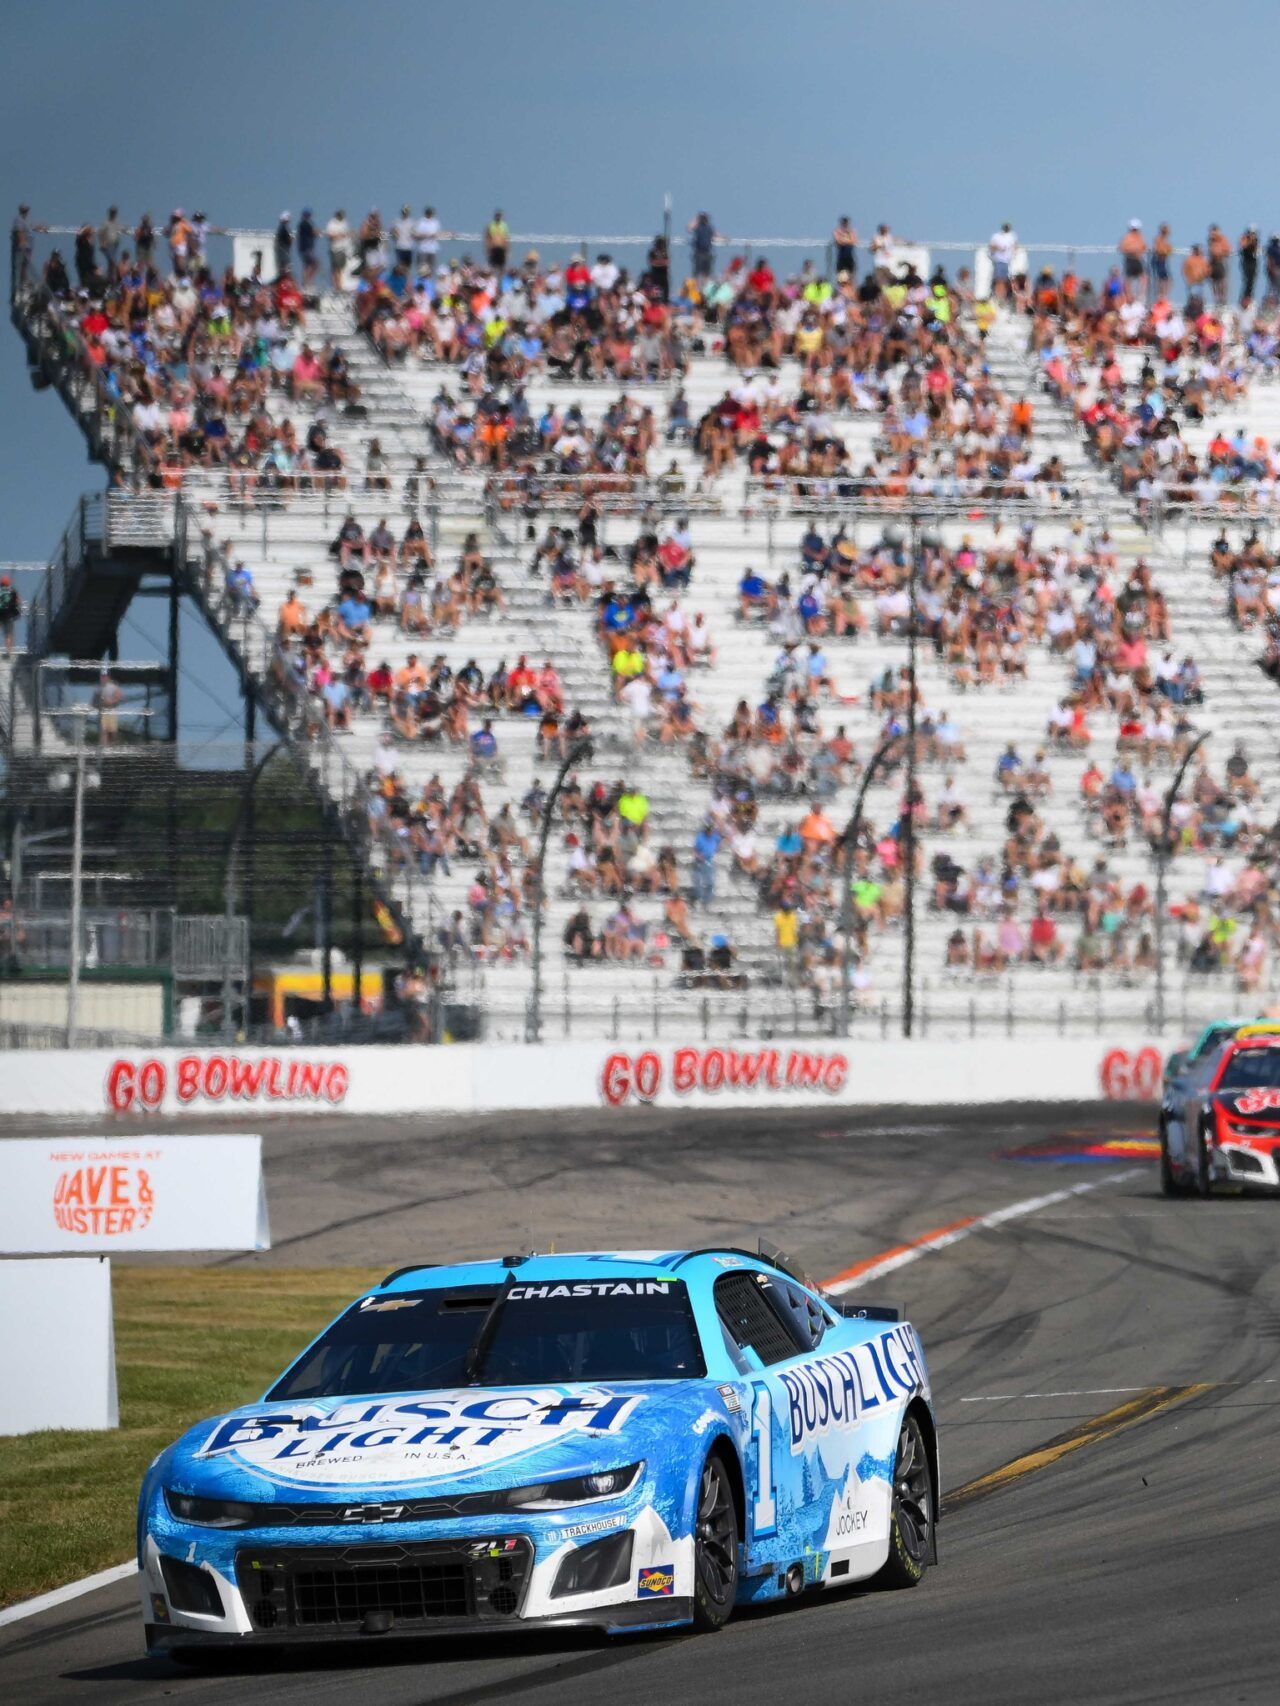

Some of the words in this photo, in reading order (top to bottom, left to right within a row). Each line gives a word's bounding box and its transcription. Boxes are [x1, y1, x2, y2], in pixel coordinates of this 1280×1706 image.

[107, 1059, 166, 1112] GO
[176, 1055, 349, 1103] BOWLING
[602, 1051, 662, 1105] GO
[673, 1047, 848, 1092] BOWLING
[1101, 1047, 1162, 1102] GO
[49, 1151, 84, 1161] NEW
[88, 1151, 140, 1160] GAMES
[136, 1168, 154, 1204] &
[506, 1282, 670, 1300] CHASTAIN
[778, 1355, 858, 1445] BUSCH
[203, 1395, 635, 1453] BUSCH
[272, 1426, 523, 1460] LIGHT
[296, 1455, 363, 1469] BREWED
[751, 1380, 778, 1542] 1
[563, 1518, 618, 1538] TRACKHOUSE
[836, 1510, 869, 1537] JOCKEY
[185, 1542, 196, 1562] 1
[468, 1538, 517, 1556] ZL1
[639, 1576, 672, 1588] SUNOCO
